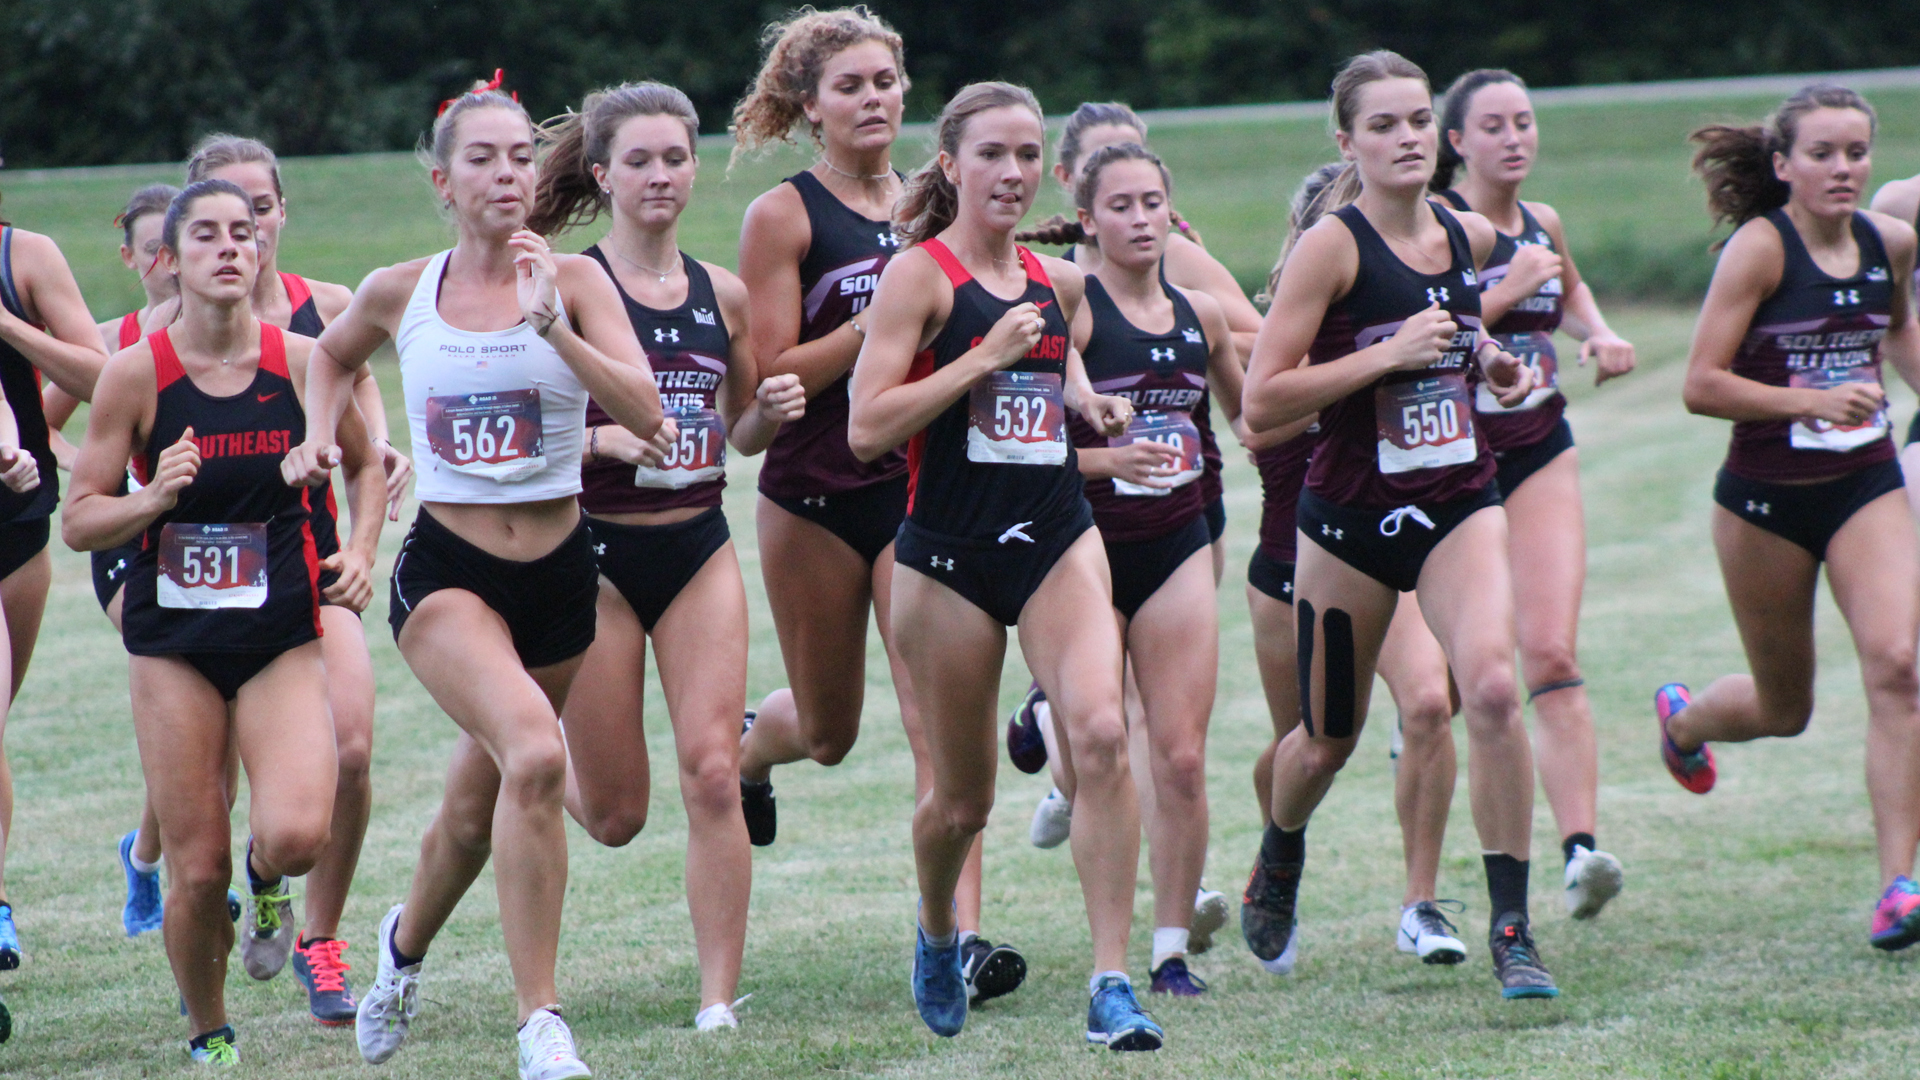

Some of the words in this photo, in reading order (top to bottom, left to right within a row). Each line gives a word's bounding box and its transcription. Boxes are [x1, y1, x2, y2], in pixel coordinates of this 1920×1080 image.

[439, 344, 475, 353] POLO
[481, 343, 527, 353] SPORT
[653, 371, 722, 391] THERN
[994, 395, 1048, 438] 532
[1402, 398, 1459, 445] 550
[190, 430, 291, 459] UTHEAST
[452, 415, 519, 461] 562
[182, 546, 240, 584] 531
